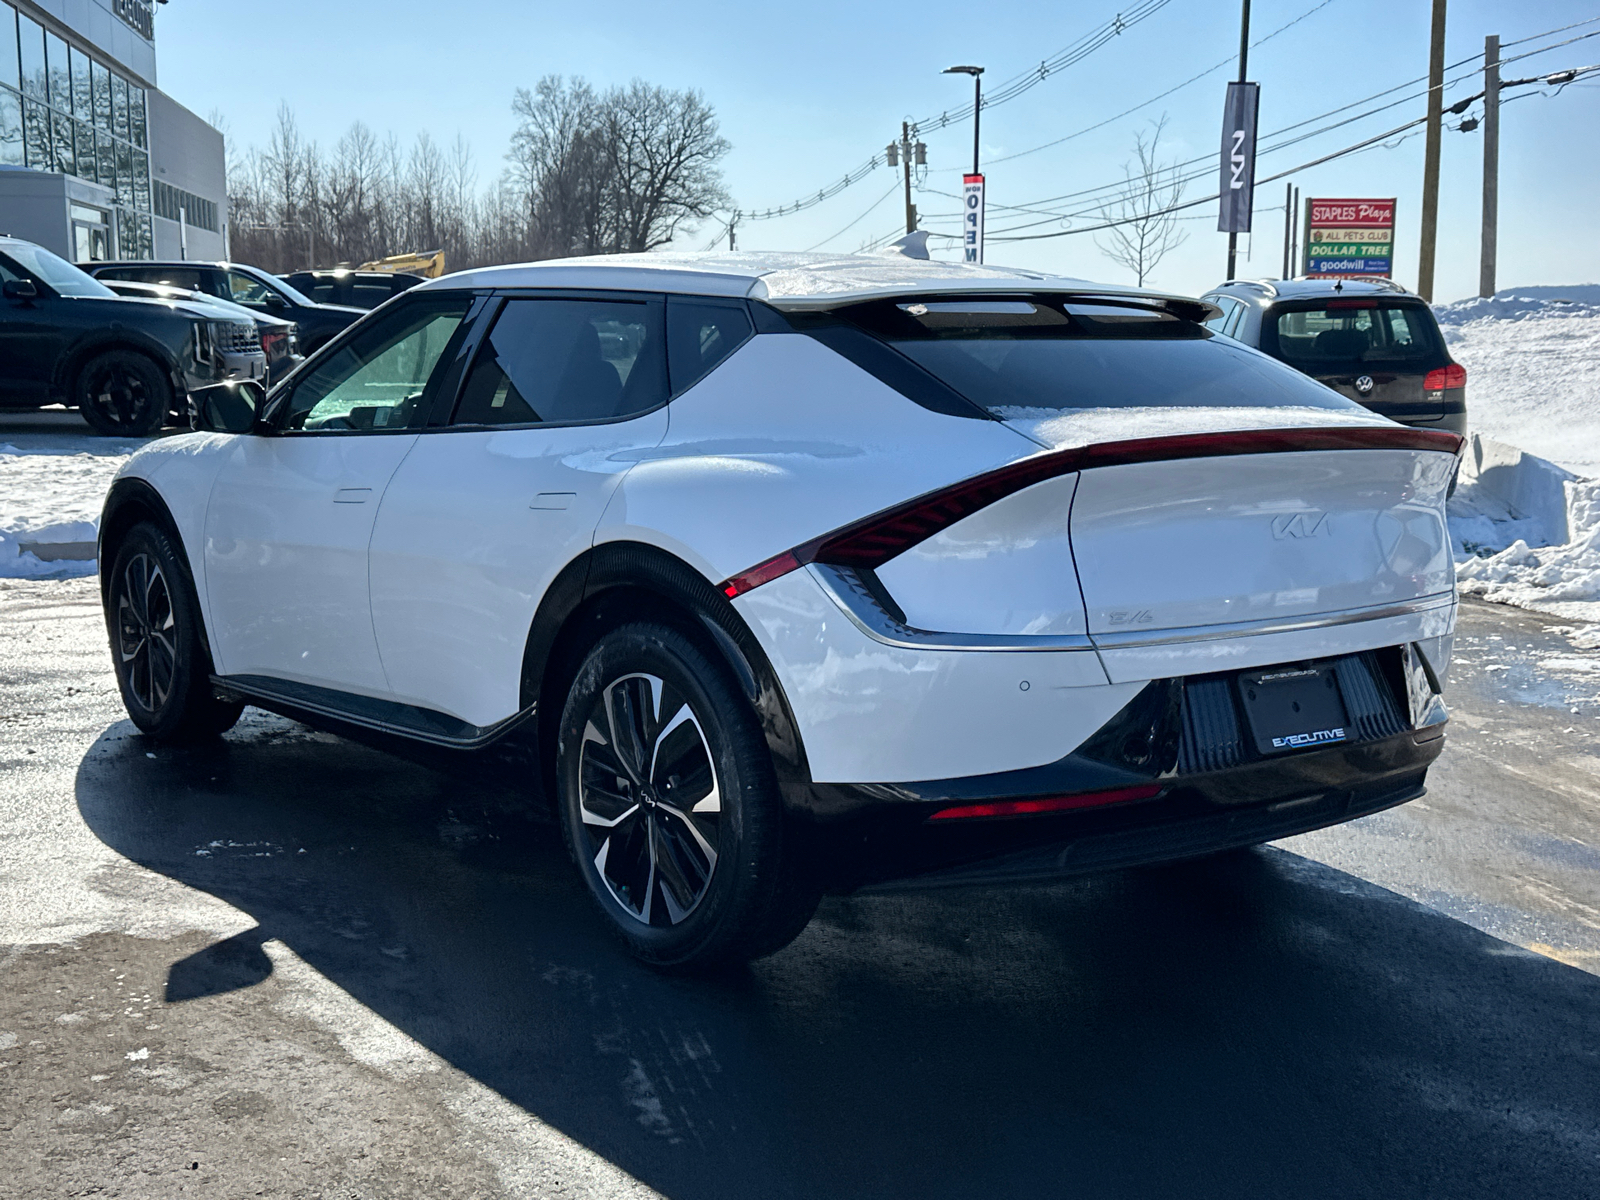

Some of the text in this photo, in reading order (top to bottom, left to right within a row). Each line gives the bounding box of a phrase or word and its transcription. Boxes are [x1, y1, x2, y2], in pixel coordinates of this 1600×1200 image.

[1312, 205, 1391, 221] STAPLES Plaza
[1326, 231, 1389, 240] ALL PETS CLUB
[1311, 246, 1389, 255] DOLLAR TREE
[1320, 260, 1364, 271] goodwill
[1272, 728, 1345, 747] EXECUTIVE
